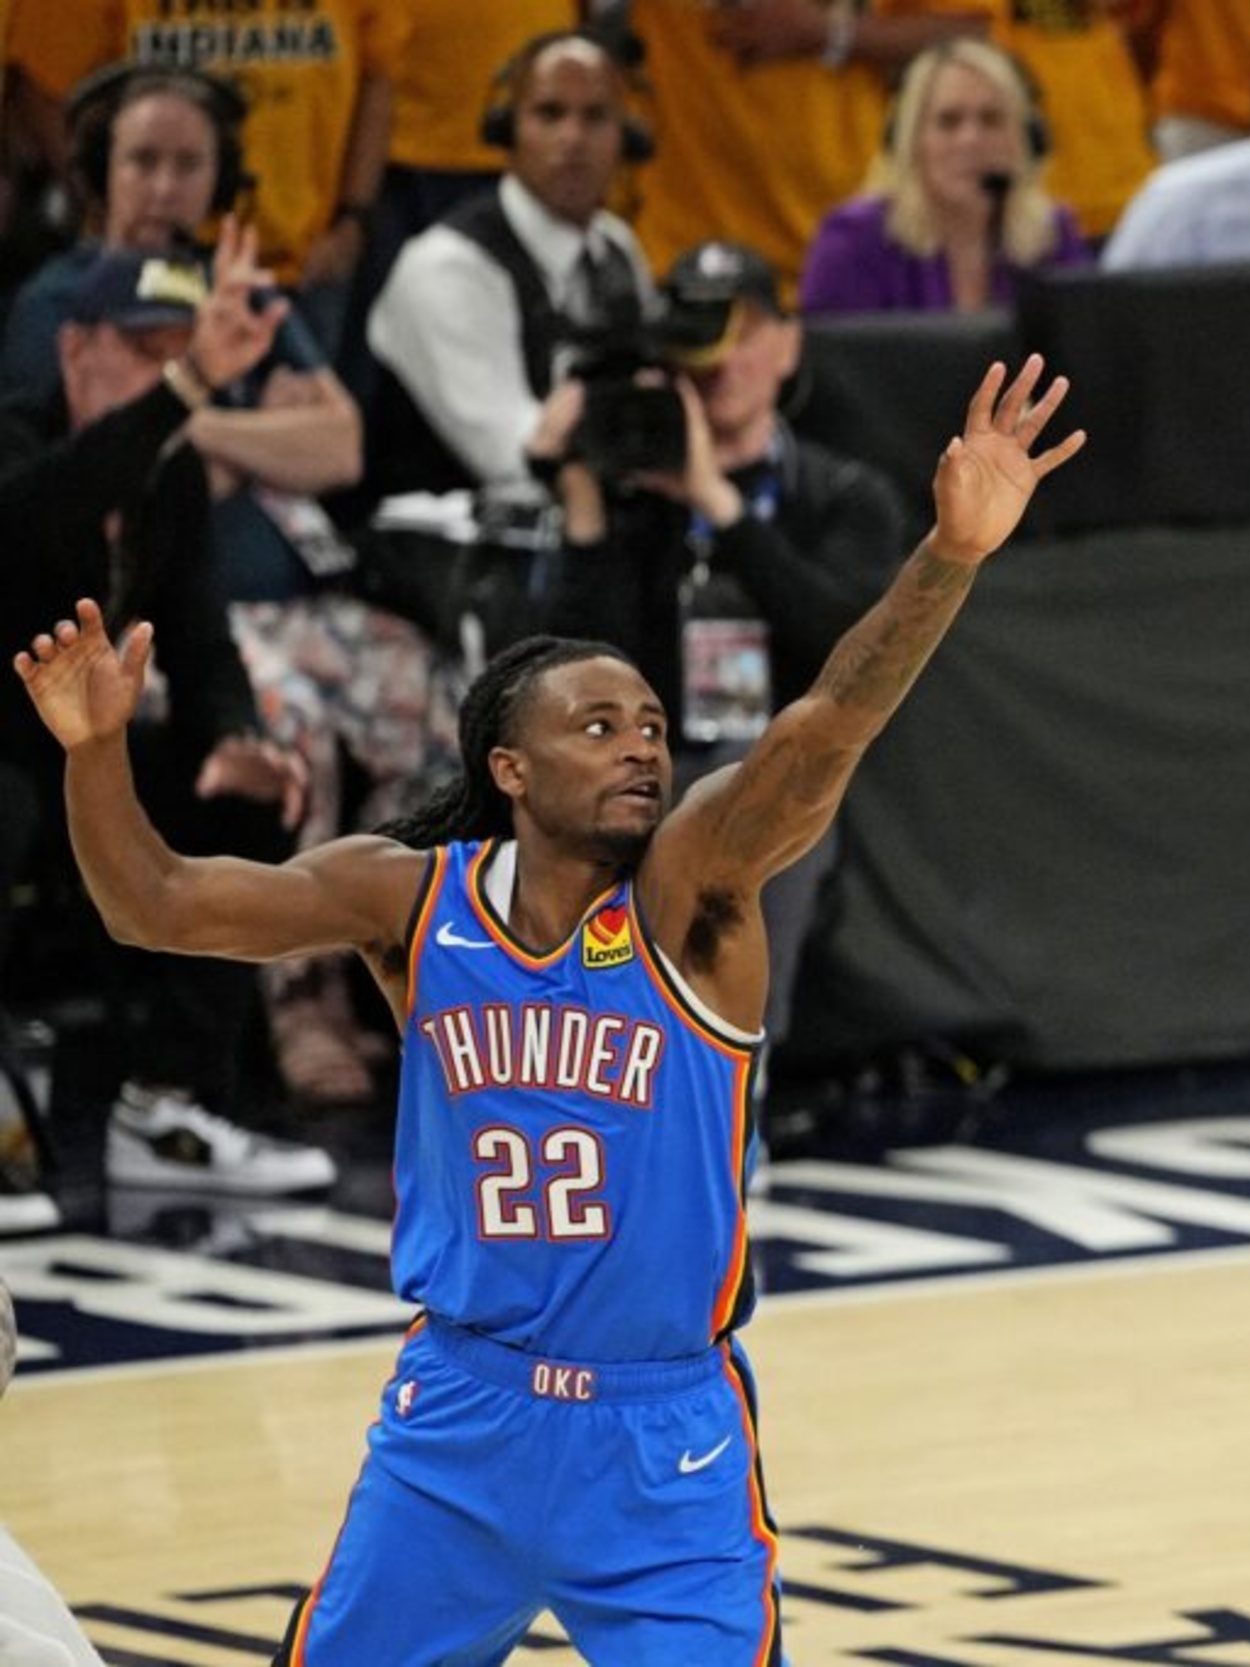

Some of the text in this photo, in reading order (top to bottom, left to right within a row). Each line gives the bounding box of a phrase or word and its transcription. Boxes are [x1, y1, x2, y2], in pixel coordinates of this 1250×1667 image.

[421, 1004, 665, 1108] THUNDER
[472, 1124, 611, 1241] 22
[533, 1361, 596, 1400] OKC
